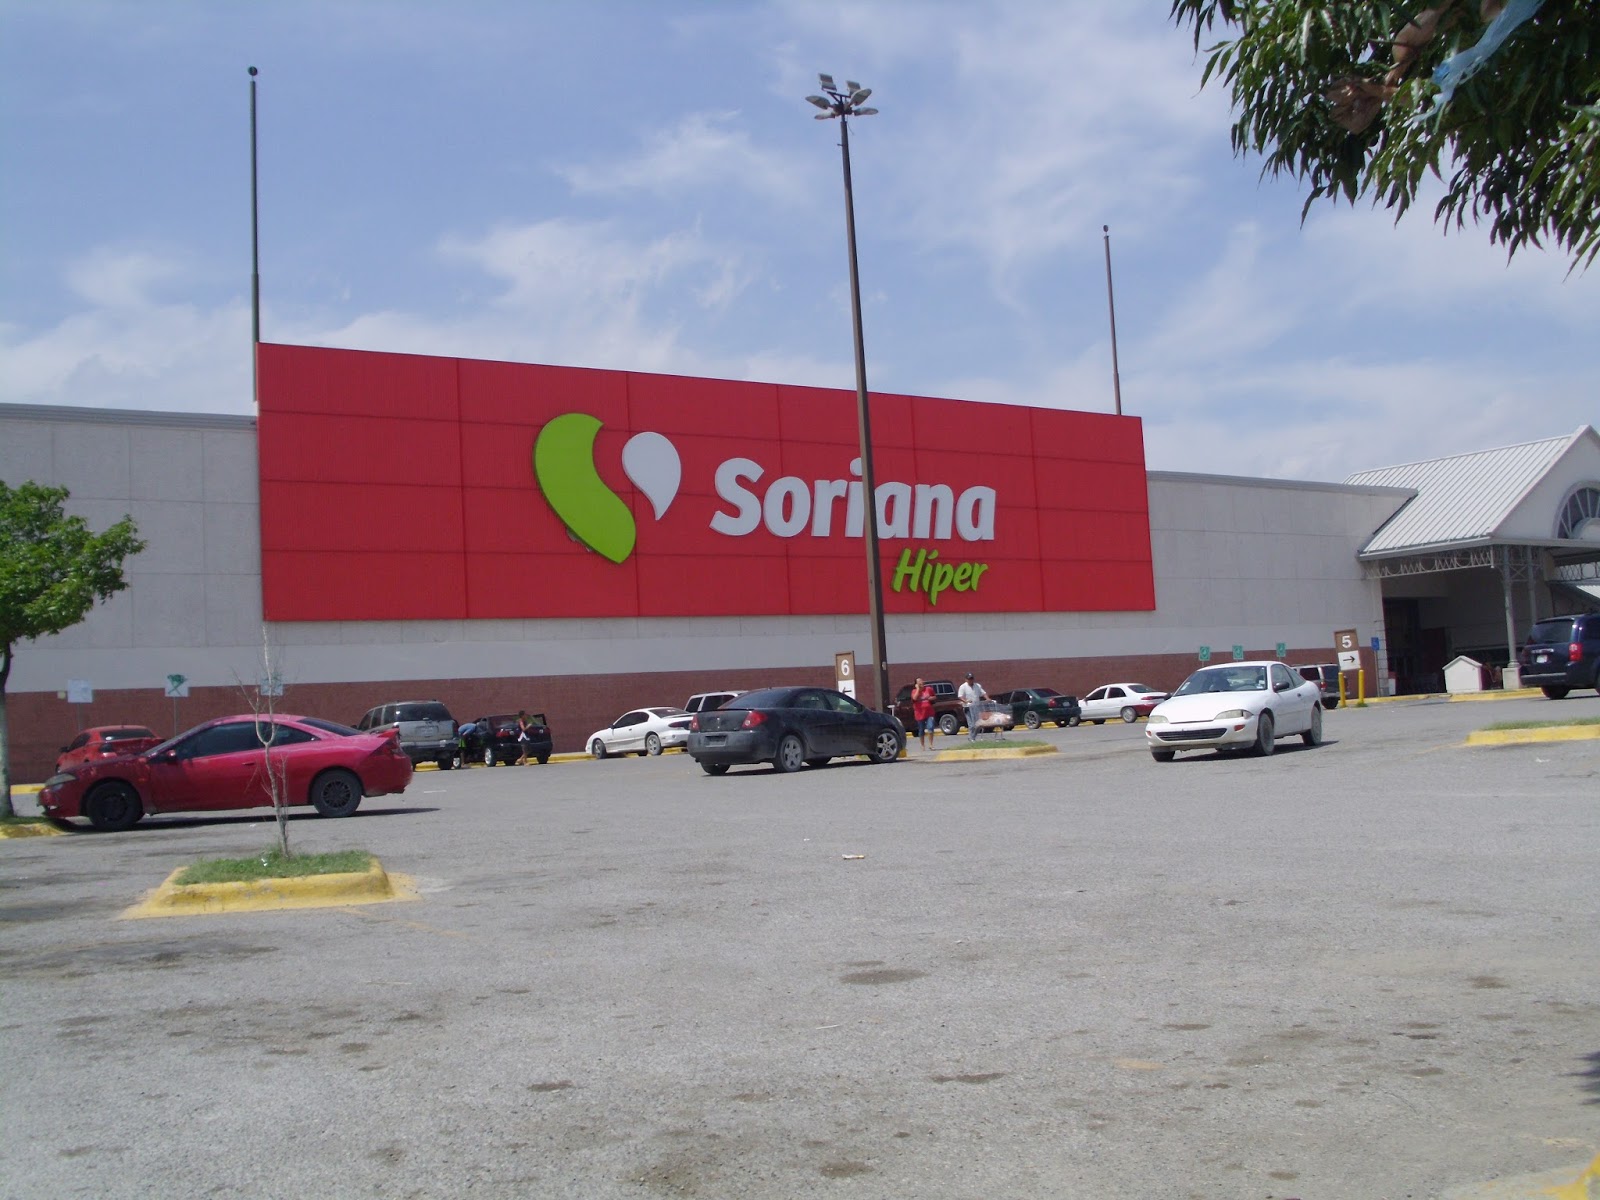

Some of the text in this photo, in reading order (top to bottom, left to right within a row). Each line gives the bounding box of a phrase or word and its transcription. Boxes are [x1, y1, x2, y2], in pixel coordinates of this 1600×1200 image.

[709, 457, 997, 541] Soriana
[1341, 635, 1352, 648] 5
[840, 659, 850, 676] 6
